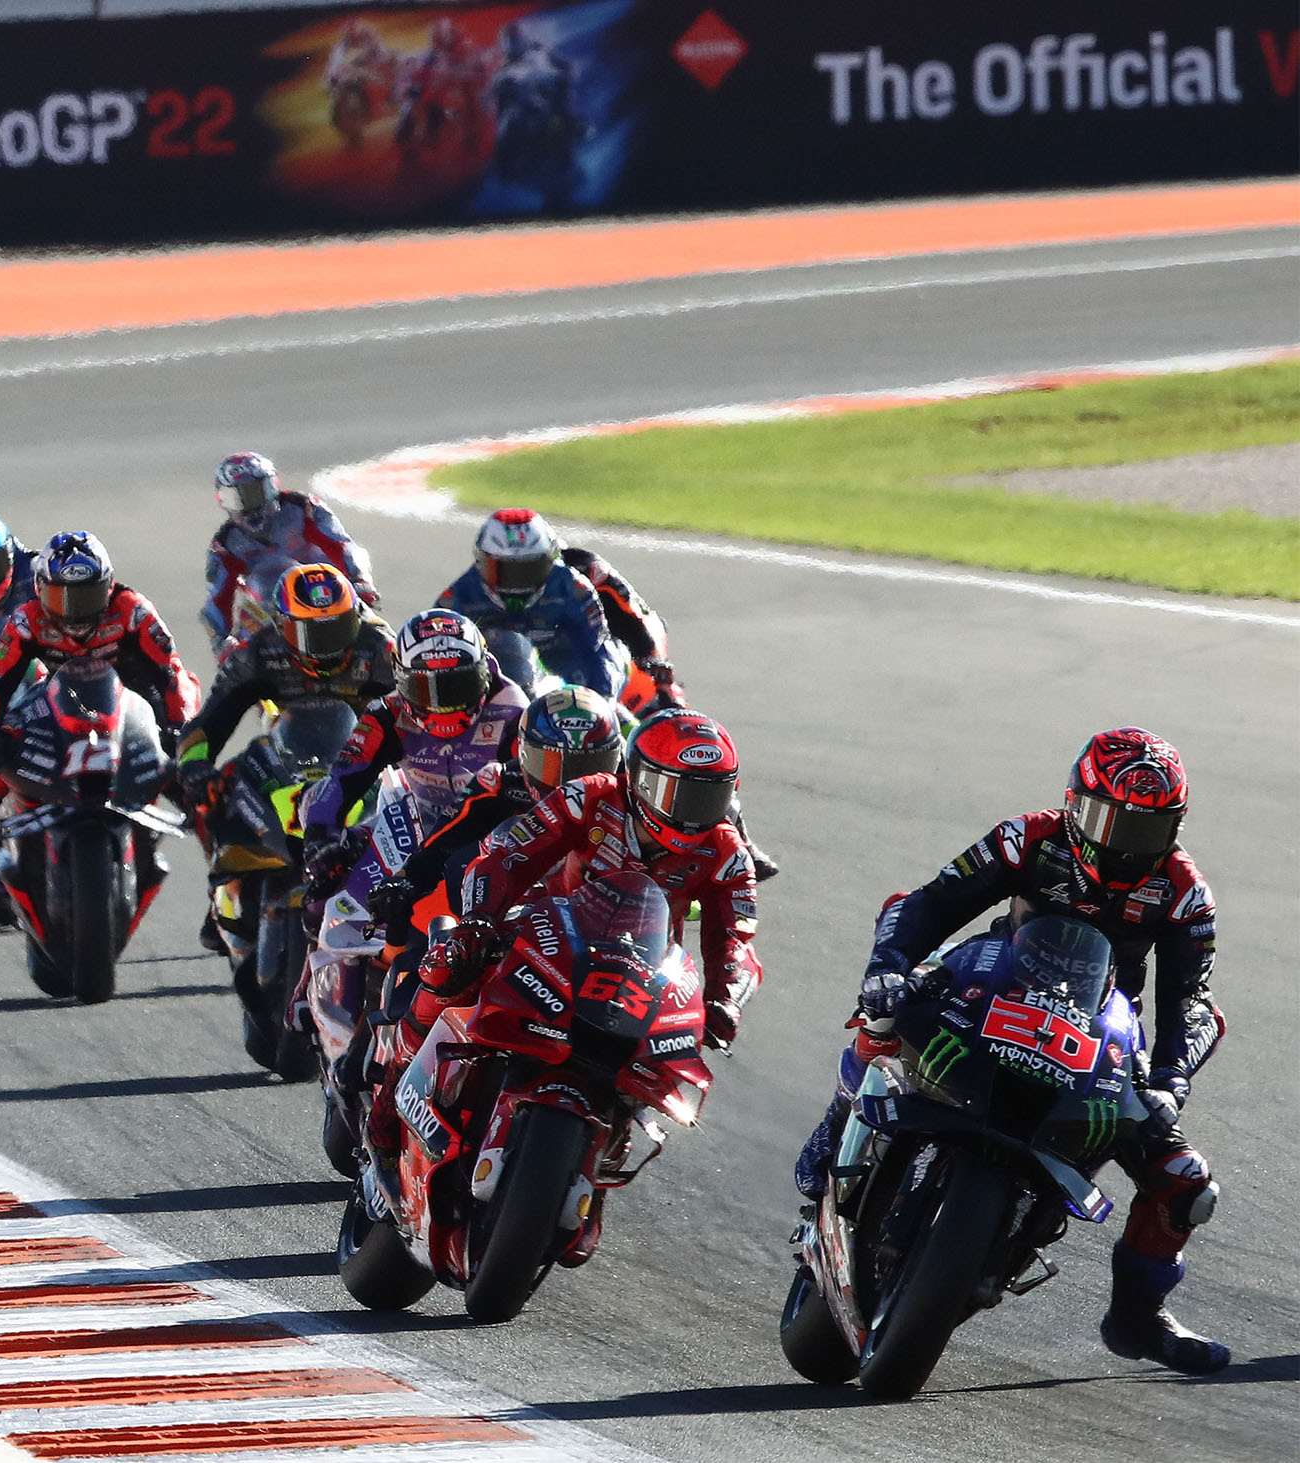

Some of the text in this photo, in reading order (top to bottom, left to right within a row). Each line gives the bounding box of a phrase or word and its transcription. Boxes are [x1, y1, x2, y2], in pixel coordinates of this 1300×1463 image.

[815, 46, 956, 125] The
[973, 27, 1242, 116] Official
[147, 87, 236, 157] 22
[421, 651, 461, 660] SHARK
[63, 736, 122, 779] 12
[683, 749, 721, 761] SUOMY
[388, 804, 413, 848] OCTO
[514, 964, 565, 1013] Lenovo
[576, 971, 653, 1020] 63
[527, 1022, 569, 1041] CARRERA
[1023, 990, 1092, 1033] ENEOS
[648, 1033, 696, 1055] Lenovo
[981, 994, 1102, 1073] 20
